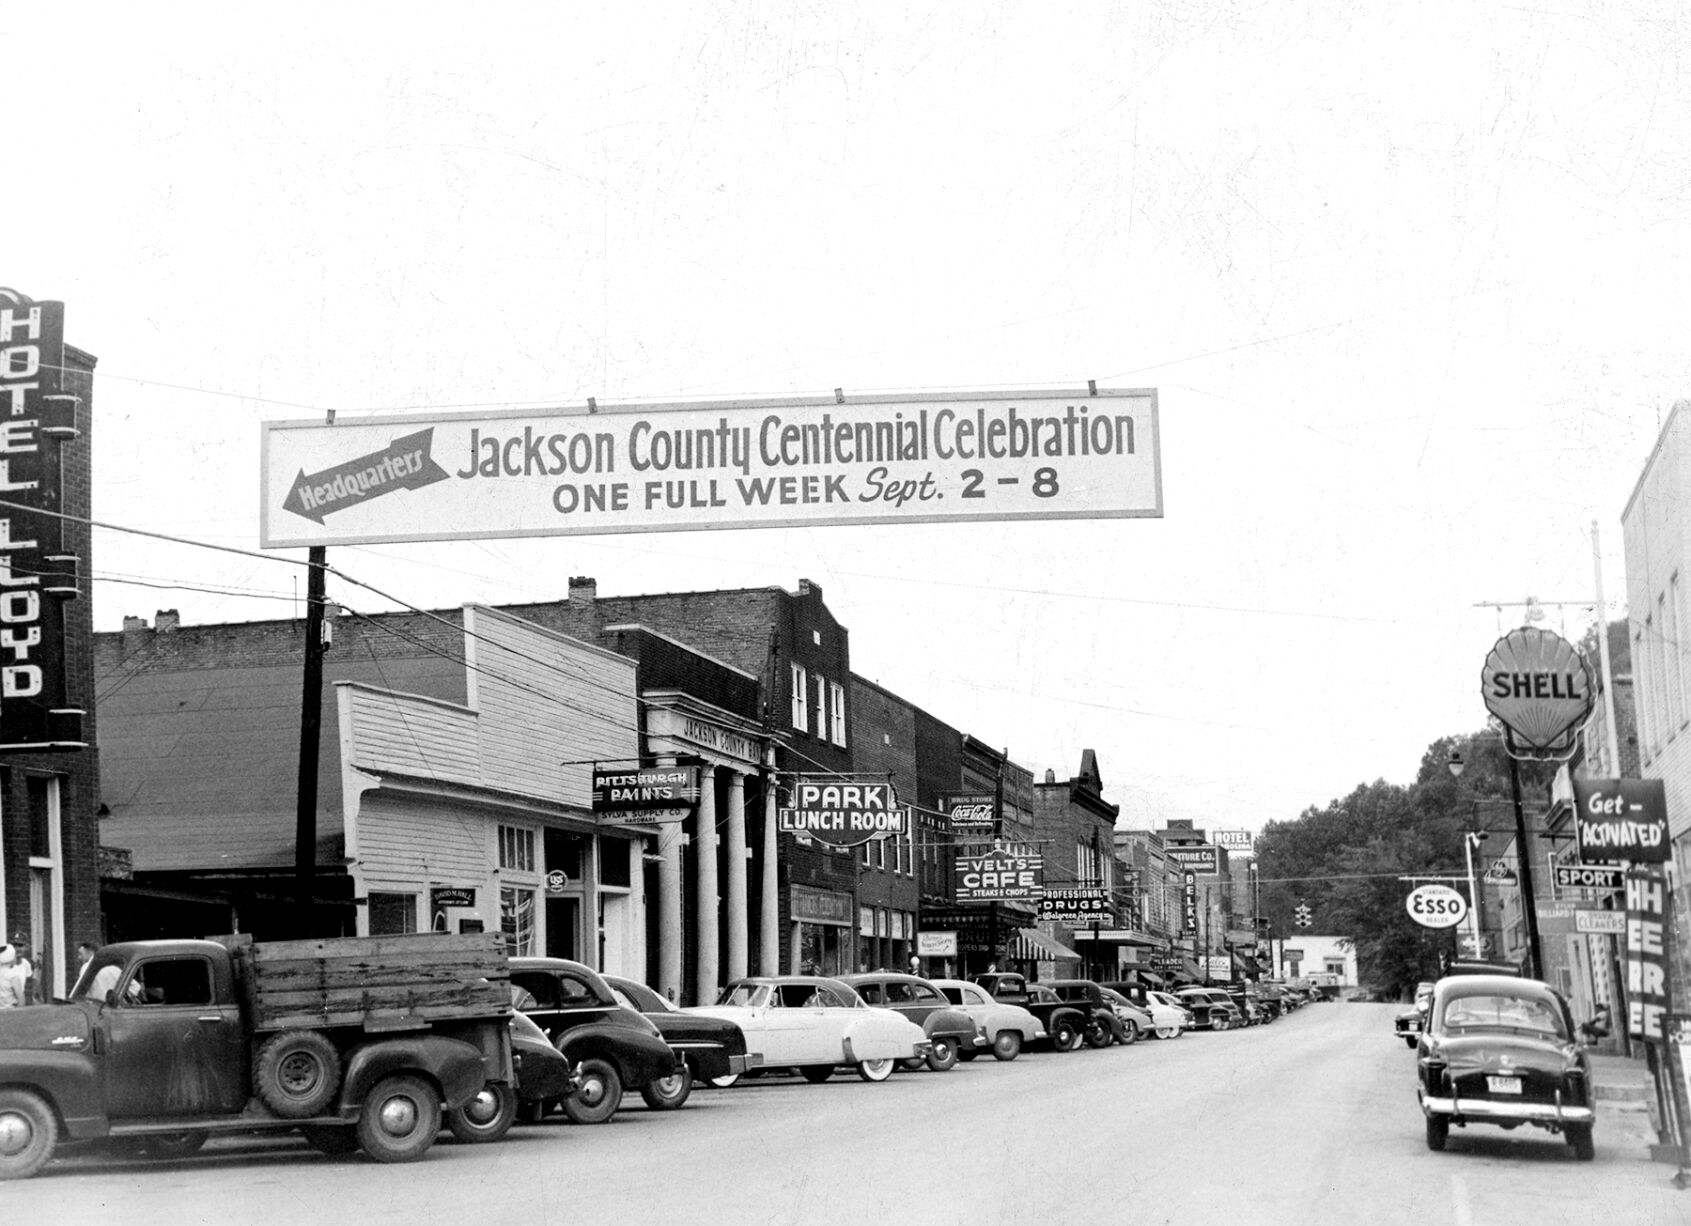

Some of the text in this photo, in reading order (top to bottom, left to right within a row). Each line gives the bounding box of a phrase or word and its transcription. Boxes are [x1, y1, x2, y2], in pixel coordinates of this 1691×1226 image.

[0, 306, 41, 492] HOTEL
[457, 406, 1135, 479] Jackson County Centennial Celebration
[553, 482, 629, 513] ONE
[645, 479, 726, 510] FULL
[735, 474, 850, 506] WEEK
[858, 467, 944, 508] Sept.
[0, 518, 43, 698] LLOYD
[1493, 672, 1582, 699] SHELL
[684, 719, 717, 746] JACKSON
[611, 787, 673, 801] PAINTS
[802, 786, 884, 809] PARK
[1588, 792, 1624, 815] Get
[601, 811, 627, 819] SYLVA
[631, 809, 664, 818] SUPPLY
[783, 811, 901, 831] LUNCH ROOM
[1215, 832, 1249, 843] HOTEL
[971, 858, 1027, 871] VELT'S
[963, 871, 1035, 888] CAFE
[1559, 870, 1615, 886] SPORT
[972, 889, 999, 897] STEAKS
[1005, 888, 1028, 897] CHOPS
[1186, 873, 1196, 929] BELKS
[1043, 900, 1102, 910] DRUGS
[1578, 917, 1625, 930] CLEANERS
[1641, 881, 1667, 1039] HERE
